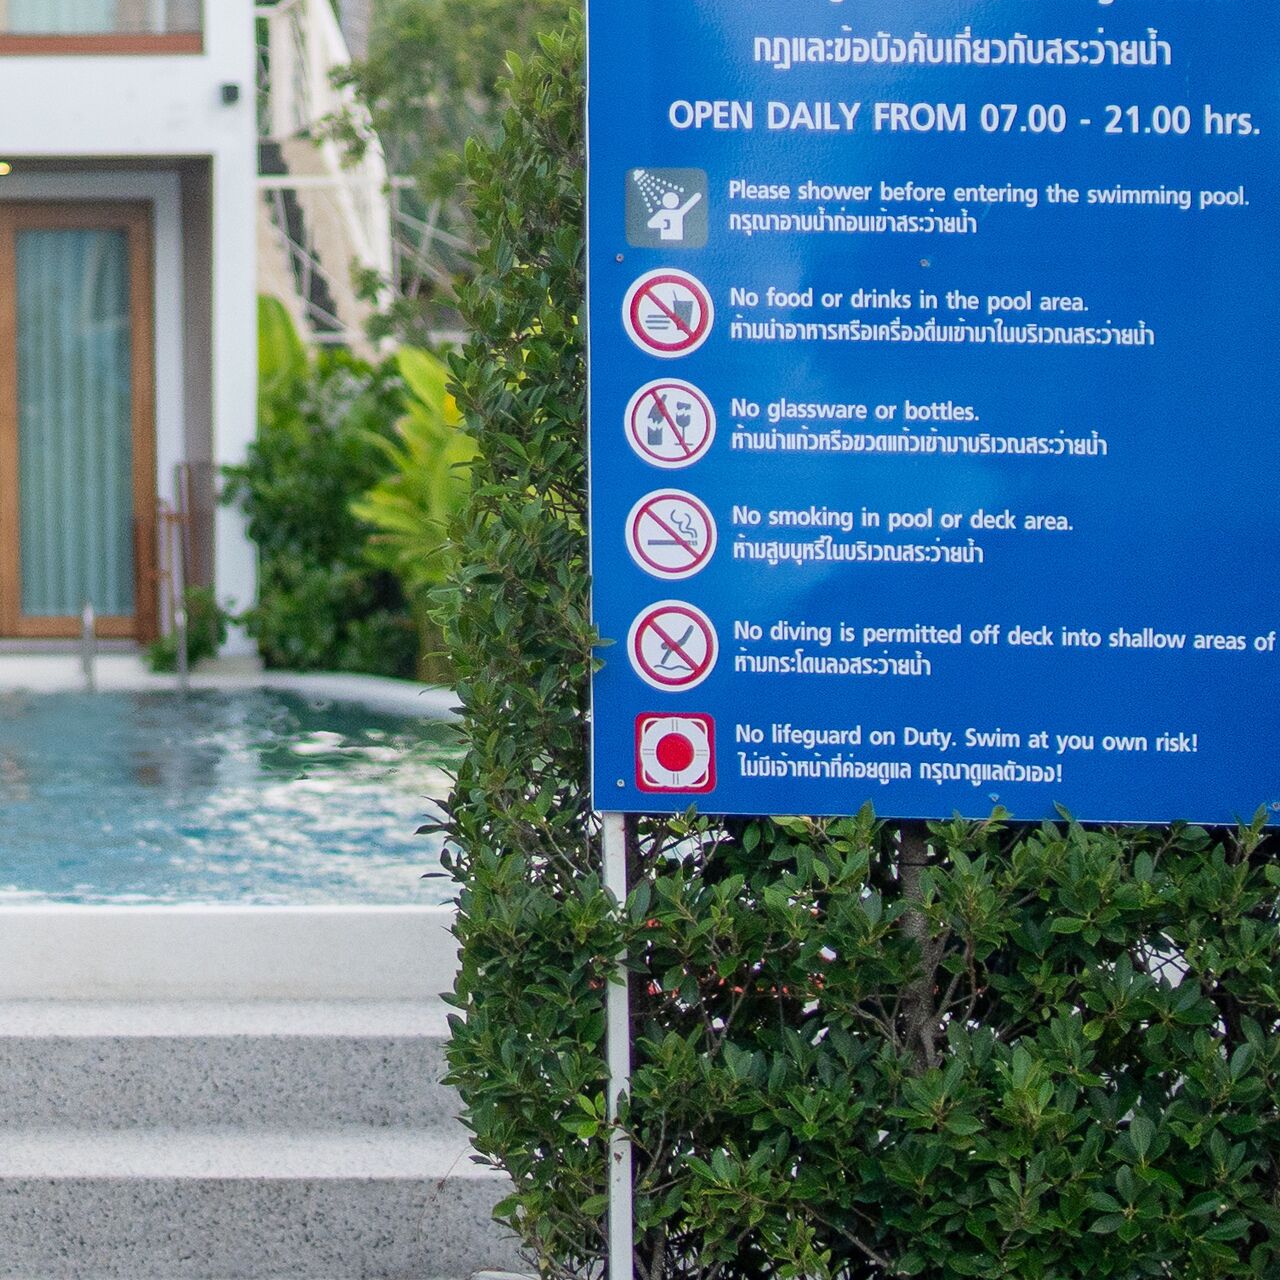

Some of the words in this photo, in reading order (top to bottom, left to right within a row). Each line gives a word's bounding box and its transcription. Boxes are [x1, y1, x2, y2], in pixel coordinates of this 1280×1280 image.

[668, 99, 754, 130] OPEN
[766, 100, 862, 132] DAILY
[873, 102, 967, 132] FROM
[980, 103, 1067, 133] 07.00
[1104, 104, 1191, 135] 21.00
[1204, 104, 1261, 136] hrs.
[727, 178, 791, 202] Please
[797, 179, 873, 201] shower
[880, 180, 946, 202] before
[953, 182, 1038, 208] entering
[1045, 183, 1080, 204] the
[1087, 184, 1192, 210] swimming
[1199, 185, 1250, 210] pool.
[729, 286, 759, 309] No
[764, 285, 814, 310] food
[821, 292, 844, 308] or
[850, 287, 912, 309] drinks
[919, 289, 938, 310] in
[945, 289, 980, 310] the
[987, 290, 1032, 315] pool
[1039, 296, 1089, 312] area.
[731, 397, 760, 419] No
[766, 397, 868, 423] glassware
[874, 404, 898, 420] or
[904, 399, 980, 422] bottles.
[731, 505, 761, 525] No
[768, 505, 854, 533] smoking
[861, 506, 880, 527] in
[888, 507, 933, 533] pool
[940, 513, 963, 529] or
[969, 508, 1017, 530] deck
[1023, 515, 1074, 531] area.
[734, 620, 762, 641] No
[769, 620, 832, 647] diving
[840, 621, 856, 642] is
[863, 623, 962, 647] permitted
[969, 623, 1001, 645] off
[1007, 624, 1054, 646] deck
[1061, 626, 1102, 648] into
[1108, 627, 1186, 649] shallow
[1193, 634, 1247, 651] areas
[1253, 630, 1276, 652] of
[735, 723, 764, 744] No
[771, 723, 862, 750] lifeguard
[869, 730, 896, 746] on
[903, 726, 957, 752] Duty.
[965, 727, 1021, 748] Swim
[1028, 730, 1050, 749] at
[1056, 734, 1095, 755] you
[1101, 735, 1148, 752] own
[1155, 731, 1198, 753] risk!
